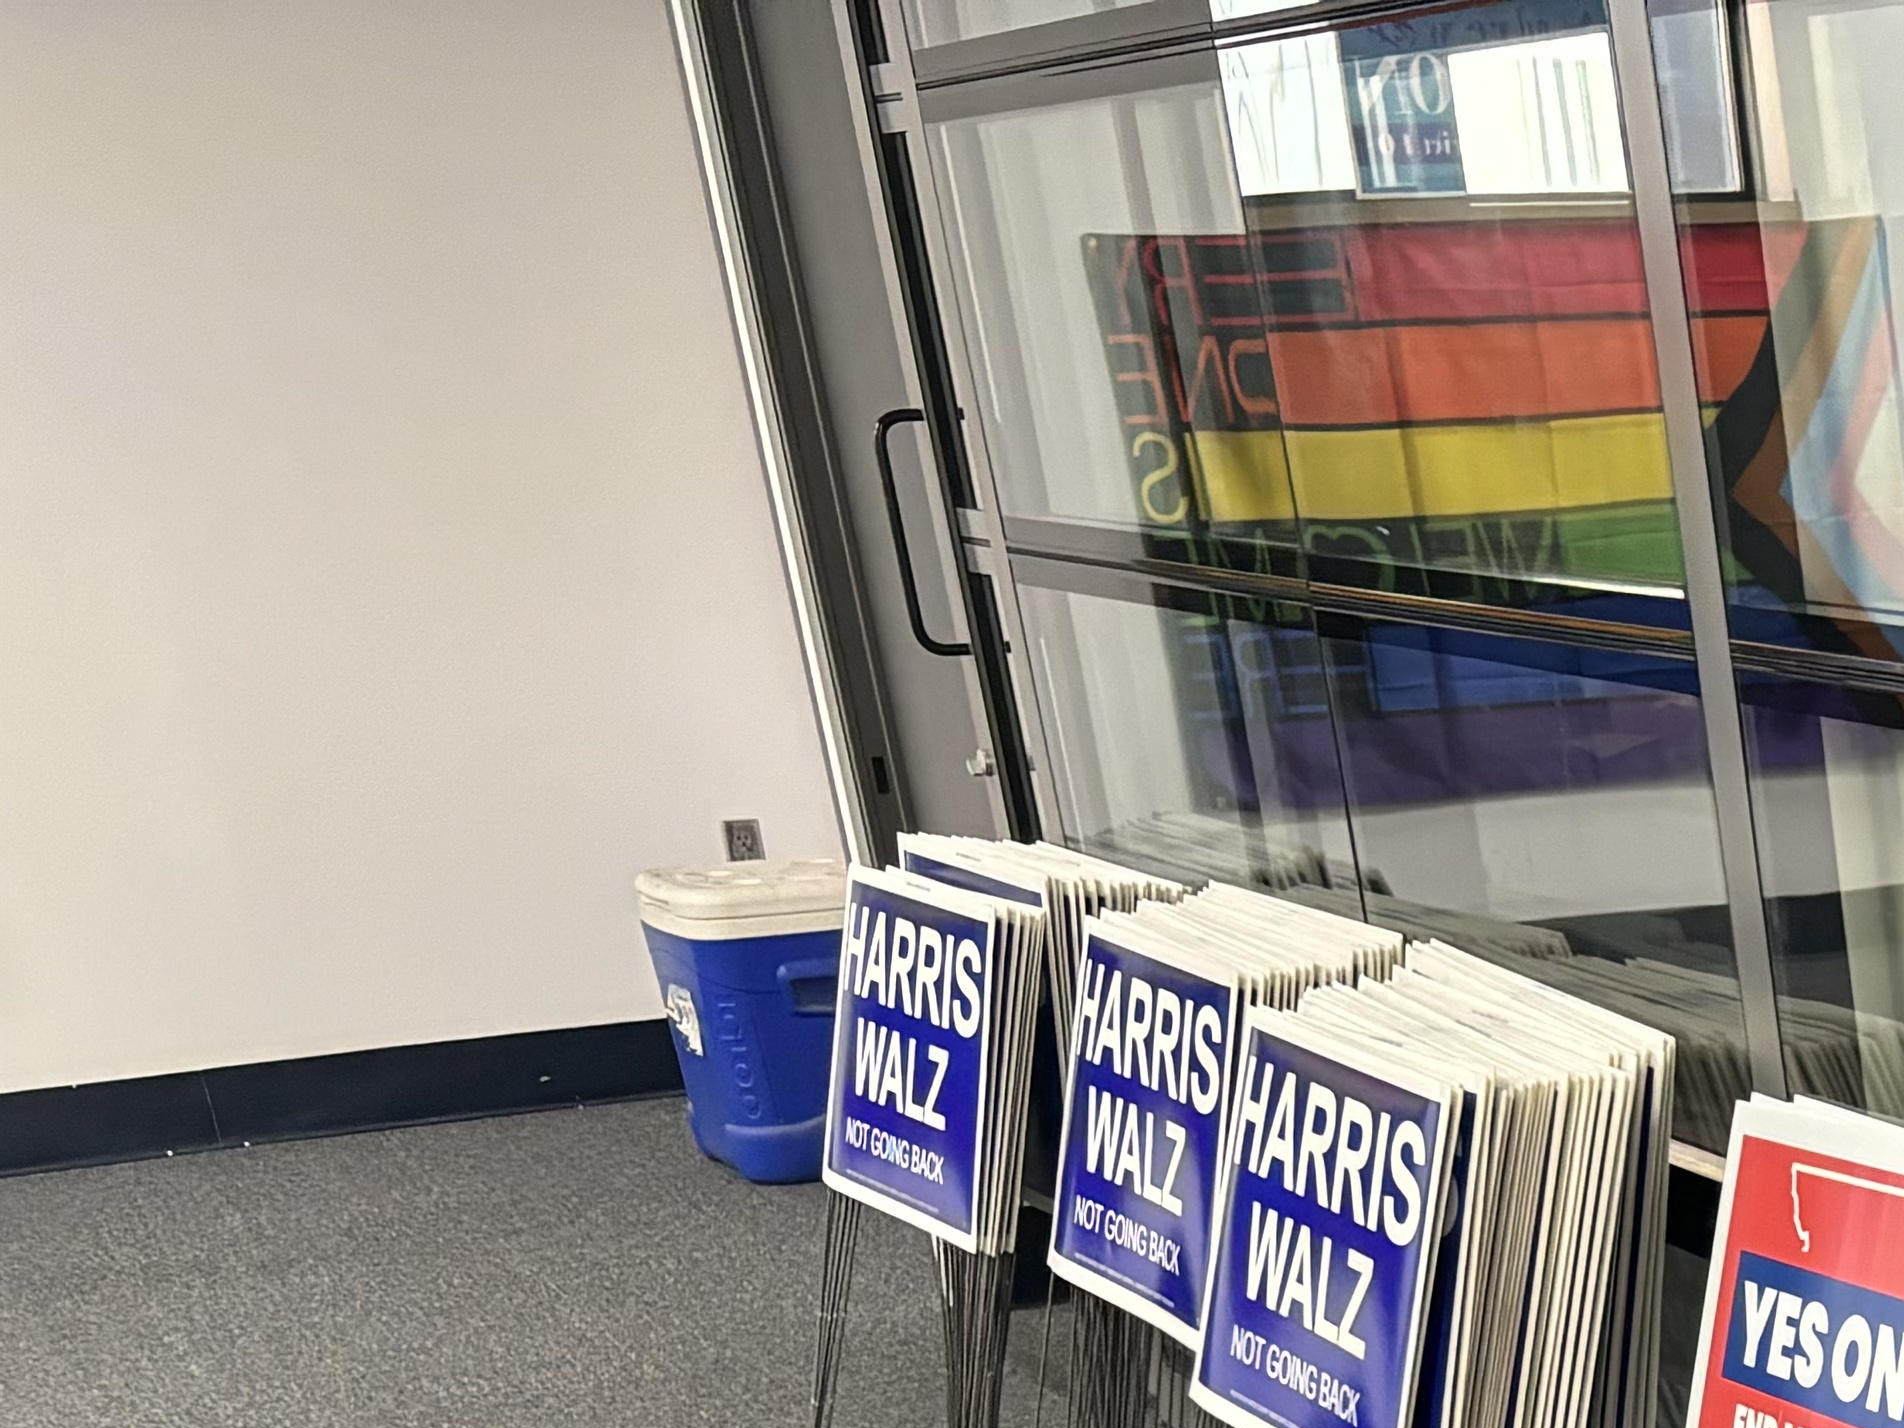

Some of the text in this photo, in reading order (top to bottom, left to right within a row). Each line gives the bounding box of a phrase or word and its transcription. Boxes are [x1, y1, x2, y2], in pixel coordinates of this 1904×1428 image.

[844, 903, 982, 1038] HARRIS
[855, 1017, 948, 1131] WALZ
[1076, 958, 1223, 1115] HARRIS
[845, 1116, 944, 1185] NOT GOING BACK
[1086, 1086, 1184, 1216] WALZ
[1233, 1055, 1427, 1246] HARRIS
[1074, 1194, 1180, 1276] NOT GOING BACK
[1246, 1201, 1374, 1360] WALZ
[1230, 1324, 1267, 1369] NOT
[1266, 1340, 1318, 1401] GOING
[1319, 1371, 1359, 1428] BACK
[1740, 1279, 1827, 1389] YES
